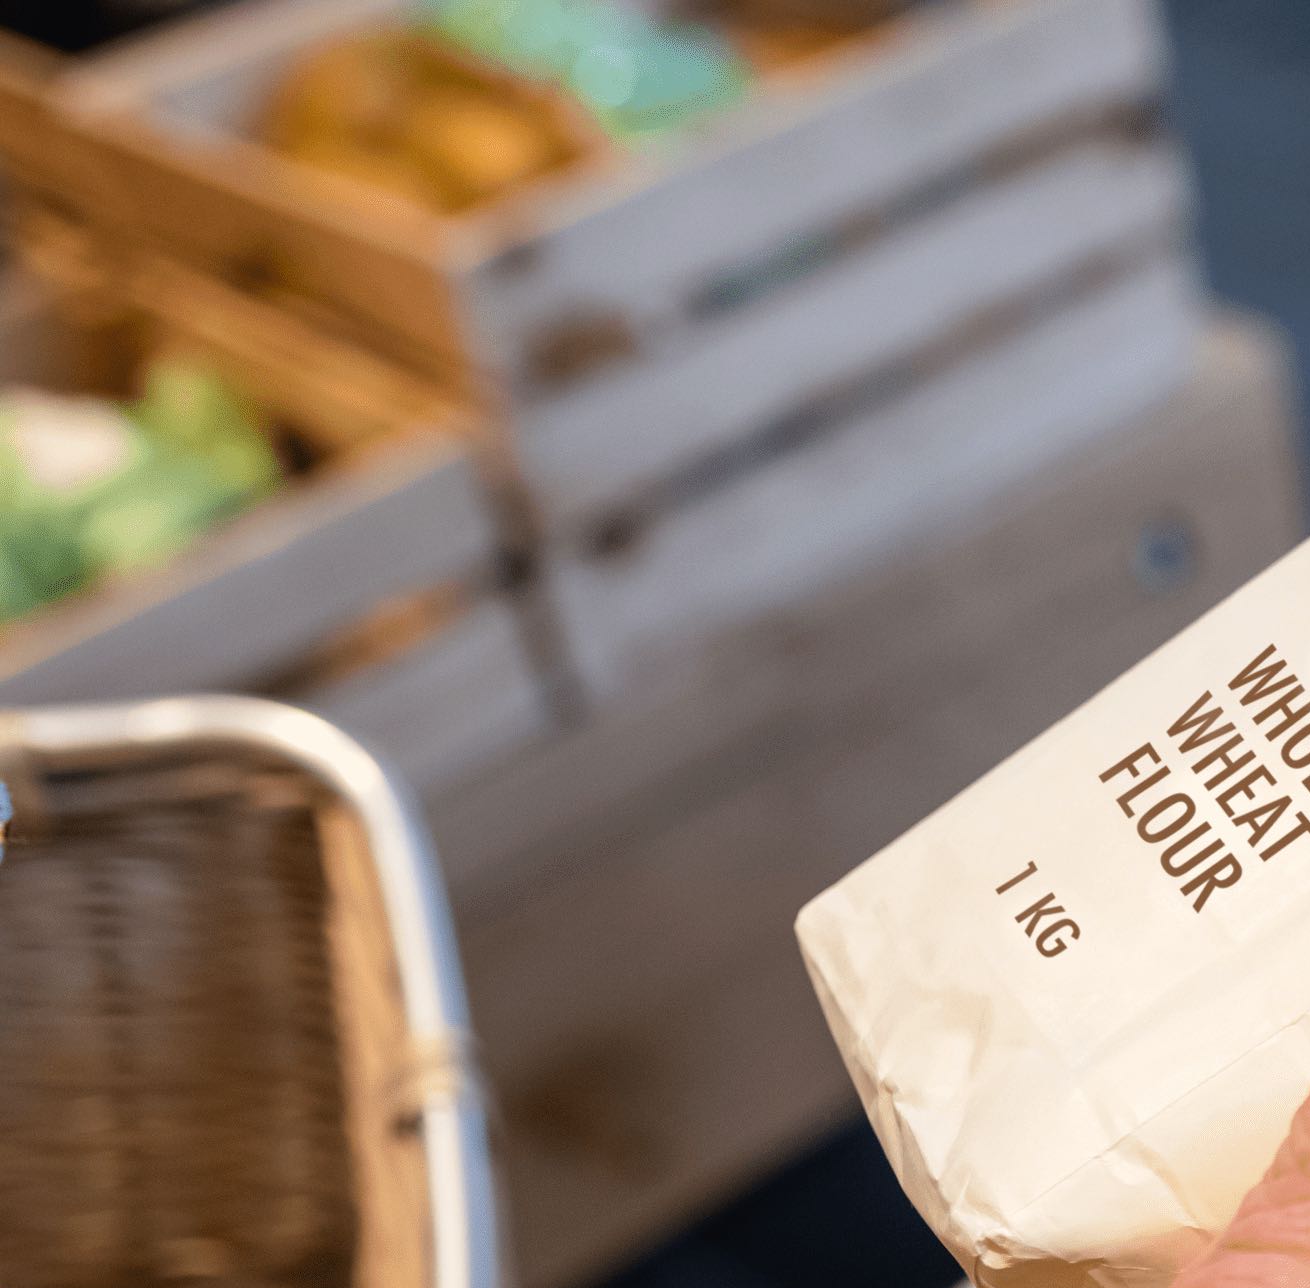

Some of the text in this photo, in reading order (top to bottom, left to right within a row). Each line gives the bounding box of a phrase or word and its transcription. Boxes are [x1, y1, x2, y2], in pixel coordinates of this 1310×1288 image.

[1098, 741, 1243, 914] FLOUR
[995, 860, 1081, 958] 1 KG
